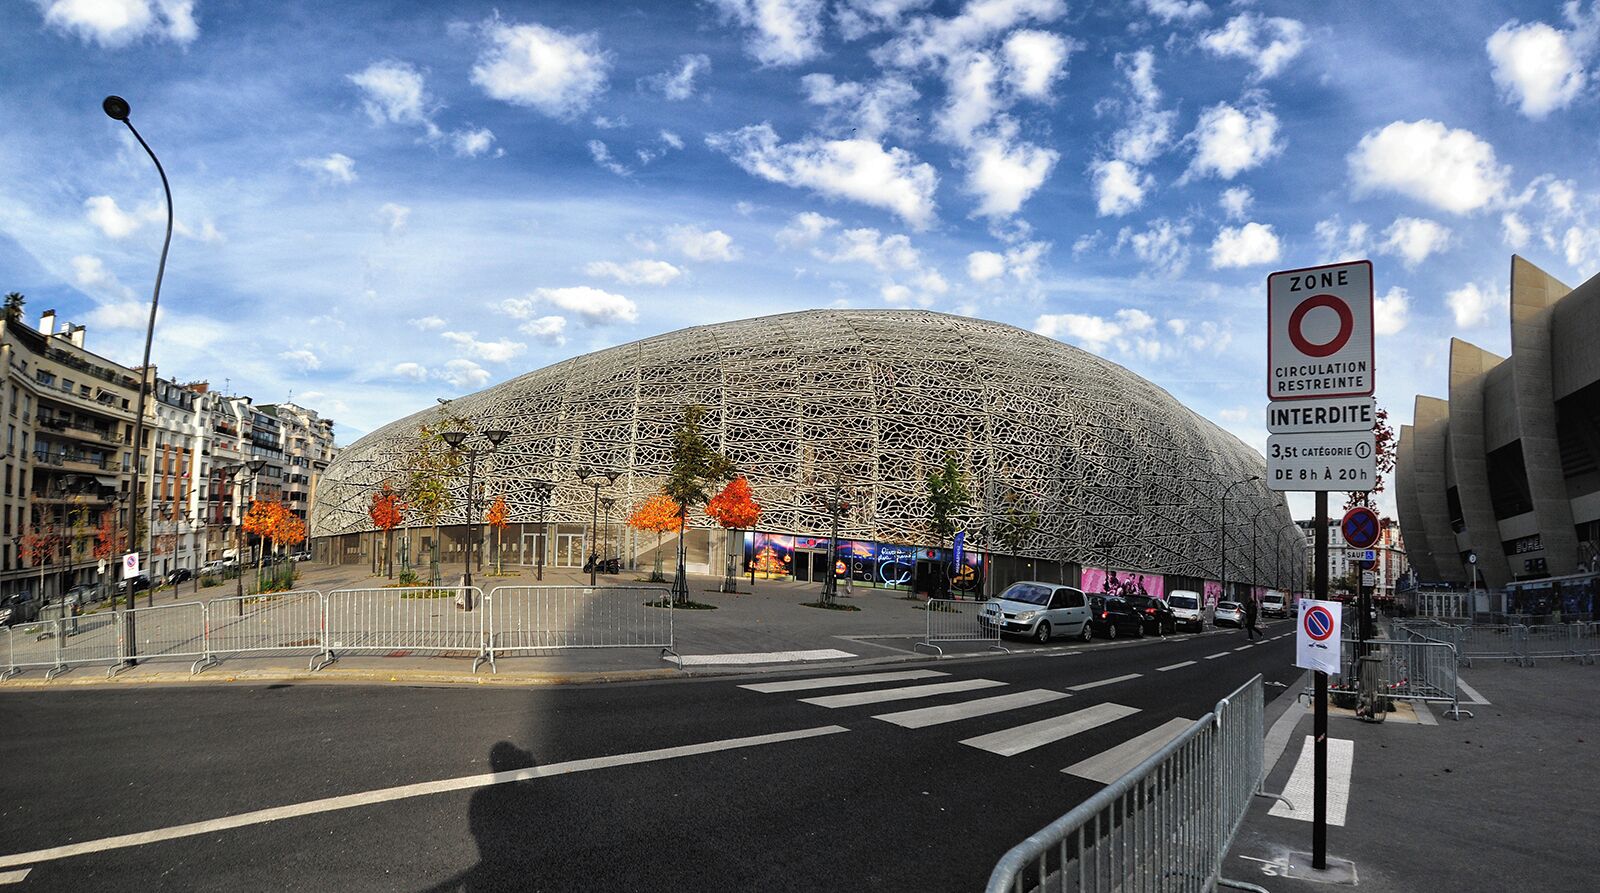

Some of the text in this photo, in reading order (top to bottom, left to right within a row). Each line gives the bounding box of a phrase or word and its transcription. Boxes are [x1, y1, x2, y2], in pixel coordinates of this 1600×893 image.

[1290, 270, 1348, 292] ZONE
[1276, 361, 1366, 378] CIRCULATION
[1278, 376, 1363, 392] RESTREINTE
[1271, 404, 1371, 426] INTERDITE
[1271, 443, 1298, 460] 3,5t
[1302, 446, 1353, 457] CATÉGORIE
[1275, 469, 1293, 480] DE
[1324, 466, 1332, 480] À
